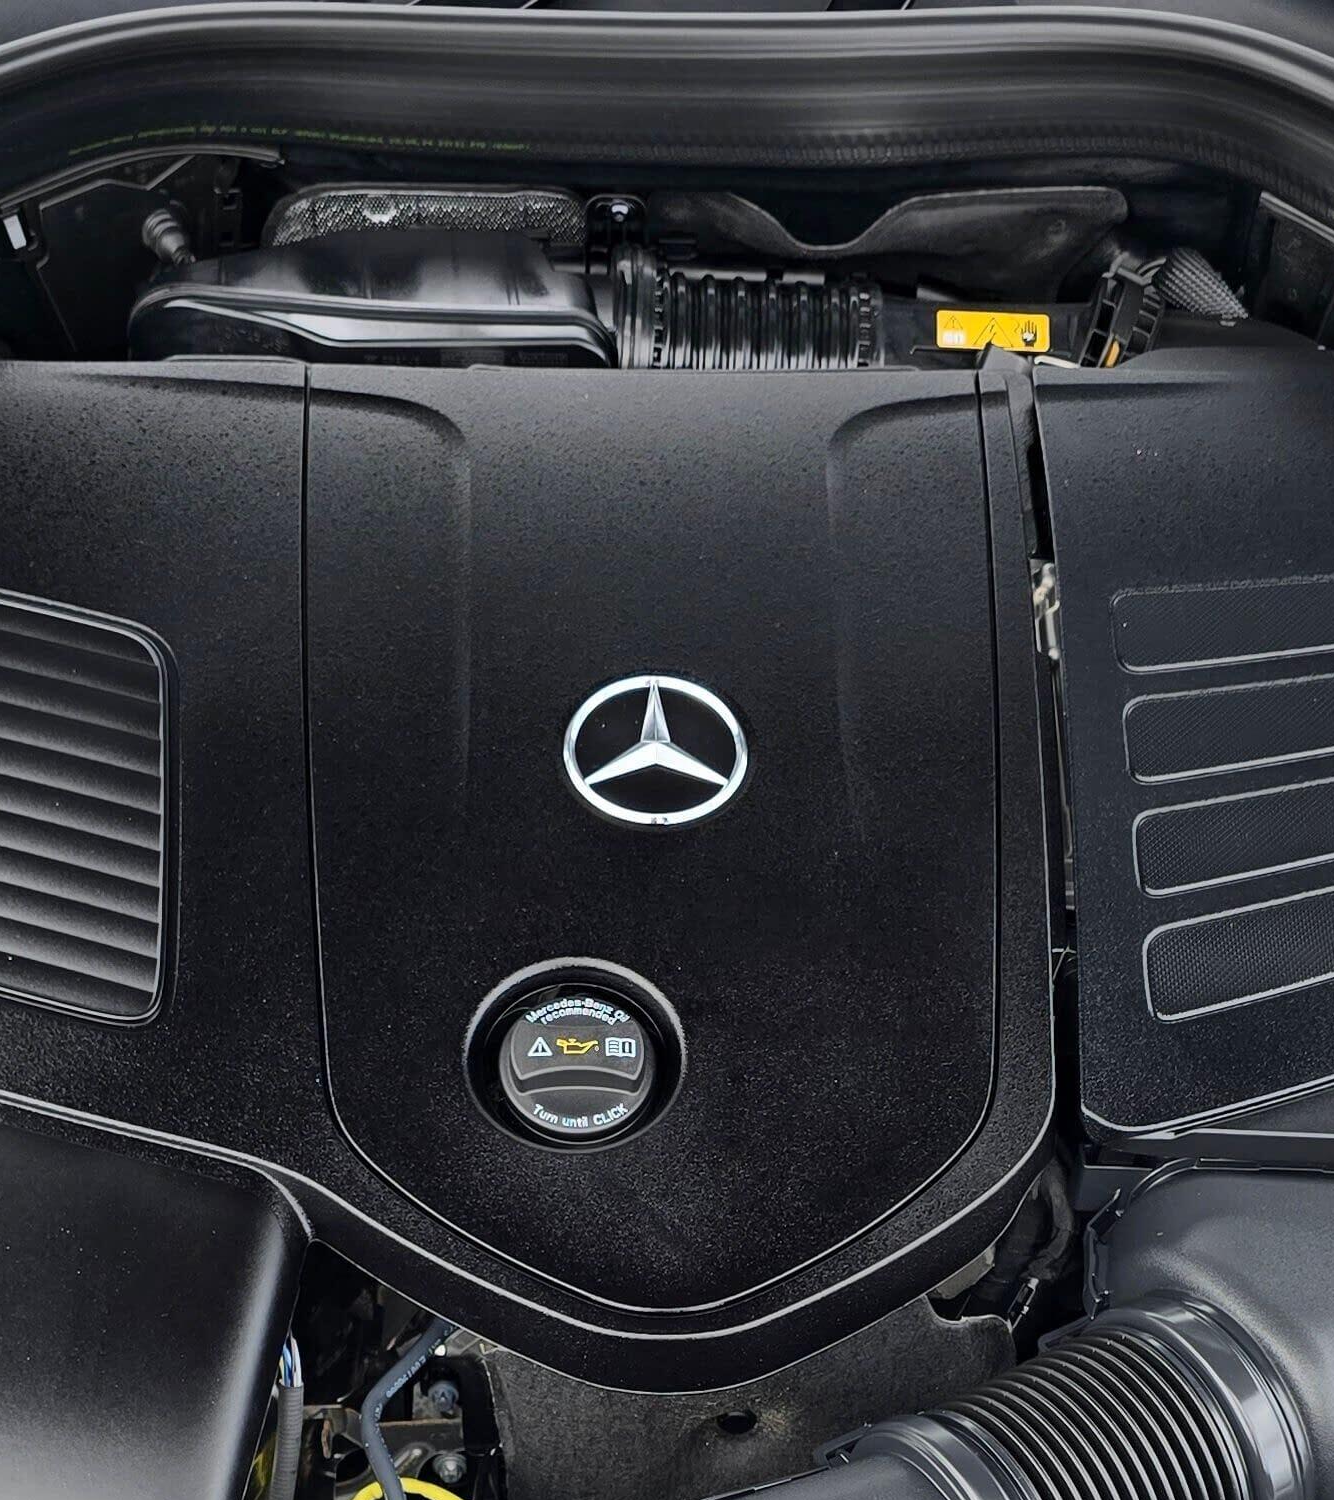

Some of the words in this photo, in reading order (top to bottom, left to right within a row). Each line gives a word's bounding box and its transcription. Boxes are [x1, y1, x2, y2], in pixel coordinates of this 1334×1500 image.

[525, 998, 613, 1024] Mercedes-Benz
[541, 1007, 617, 1026] recommended
[533, 1103, 559, 1124] Turn
[562, 1116, 589, 1128] until
[593, 1102, 629, 1125] CLICK
